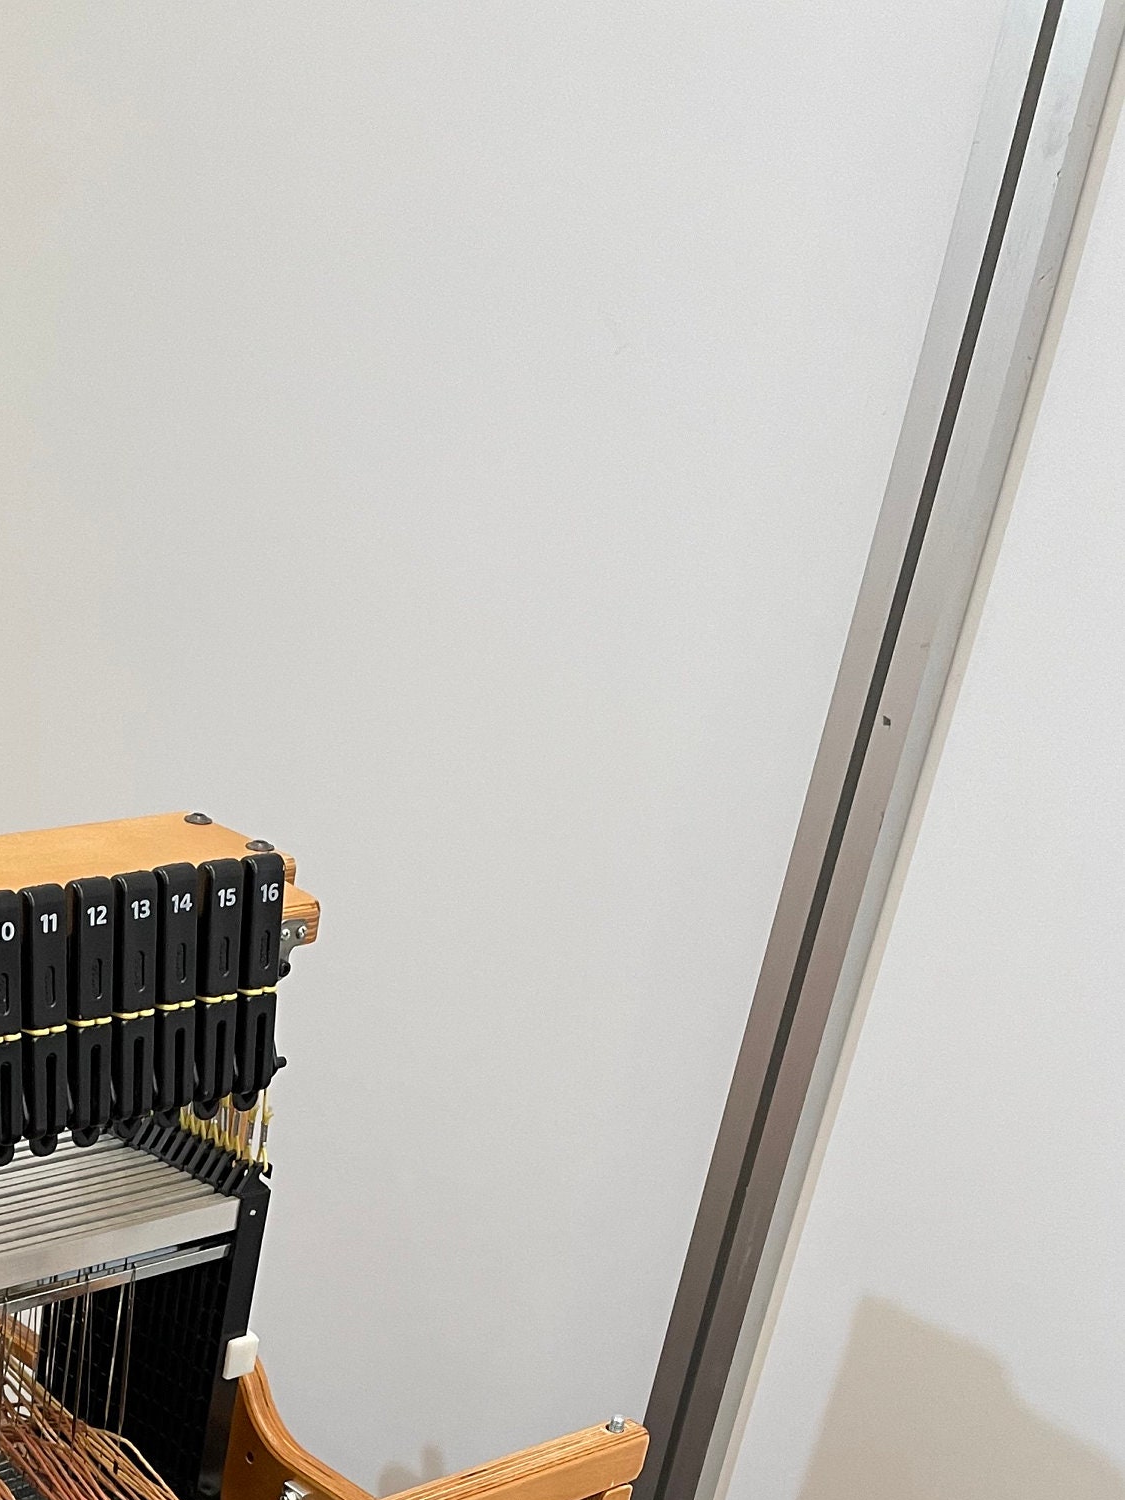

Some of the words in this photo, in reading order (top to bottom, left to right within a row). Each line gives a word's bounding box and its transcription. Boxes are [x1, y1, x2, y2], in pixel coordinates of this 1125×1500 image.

[40, 912, 58, 934] 11
[86, 905, 108, 927] 12
[131, 899, 151, 920] 13
[171, 893, 193, 914] 14
[217, 887, 236, 908] 15
[260, 882, 279, 903] 16
